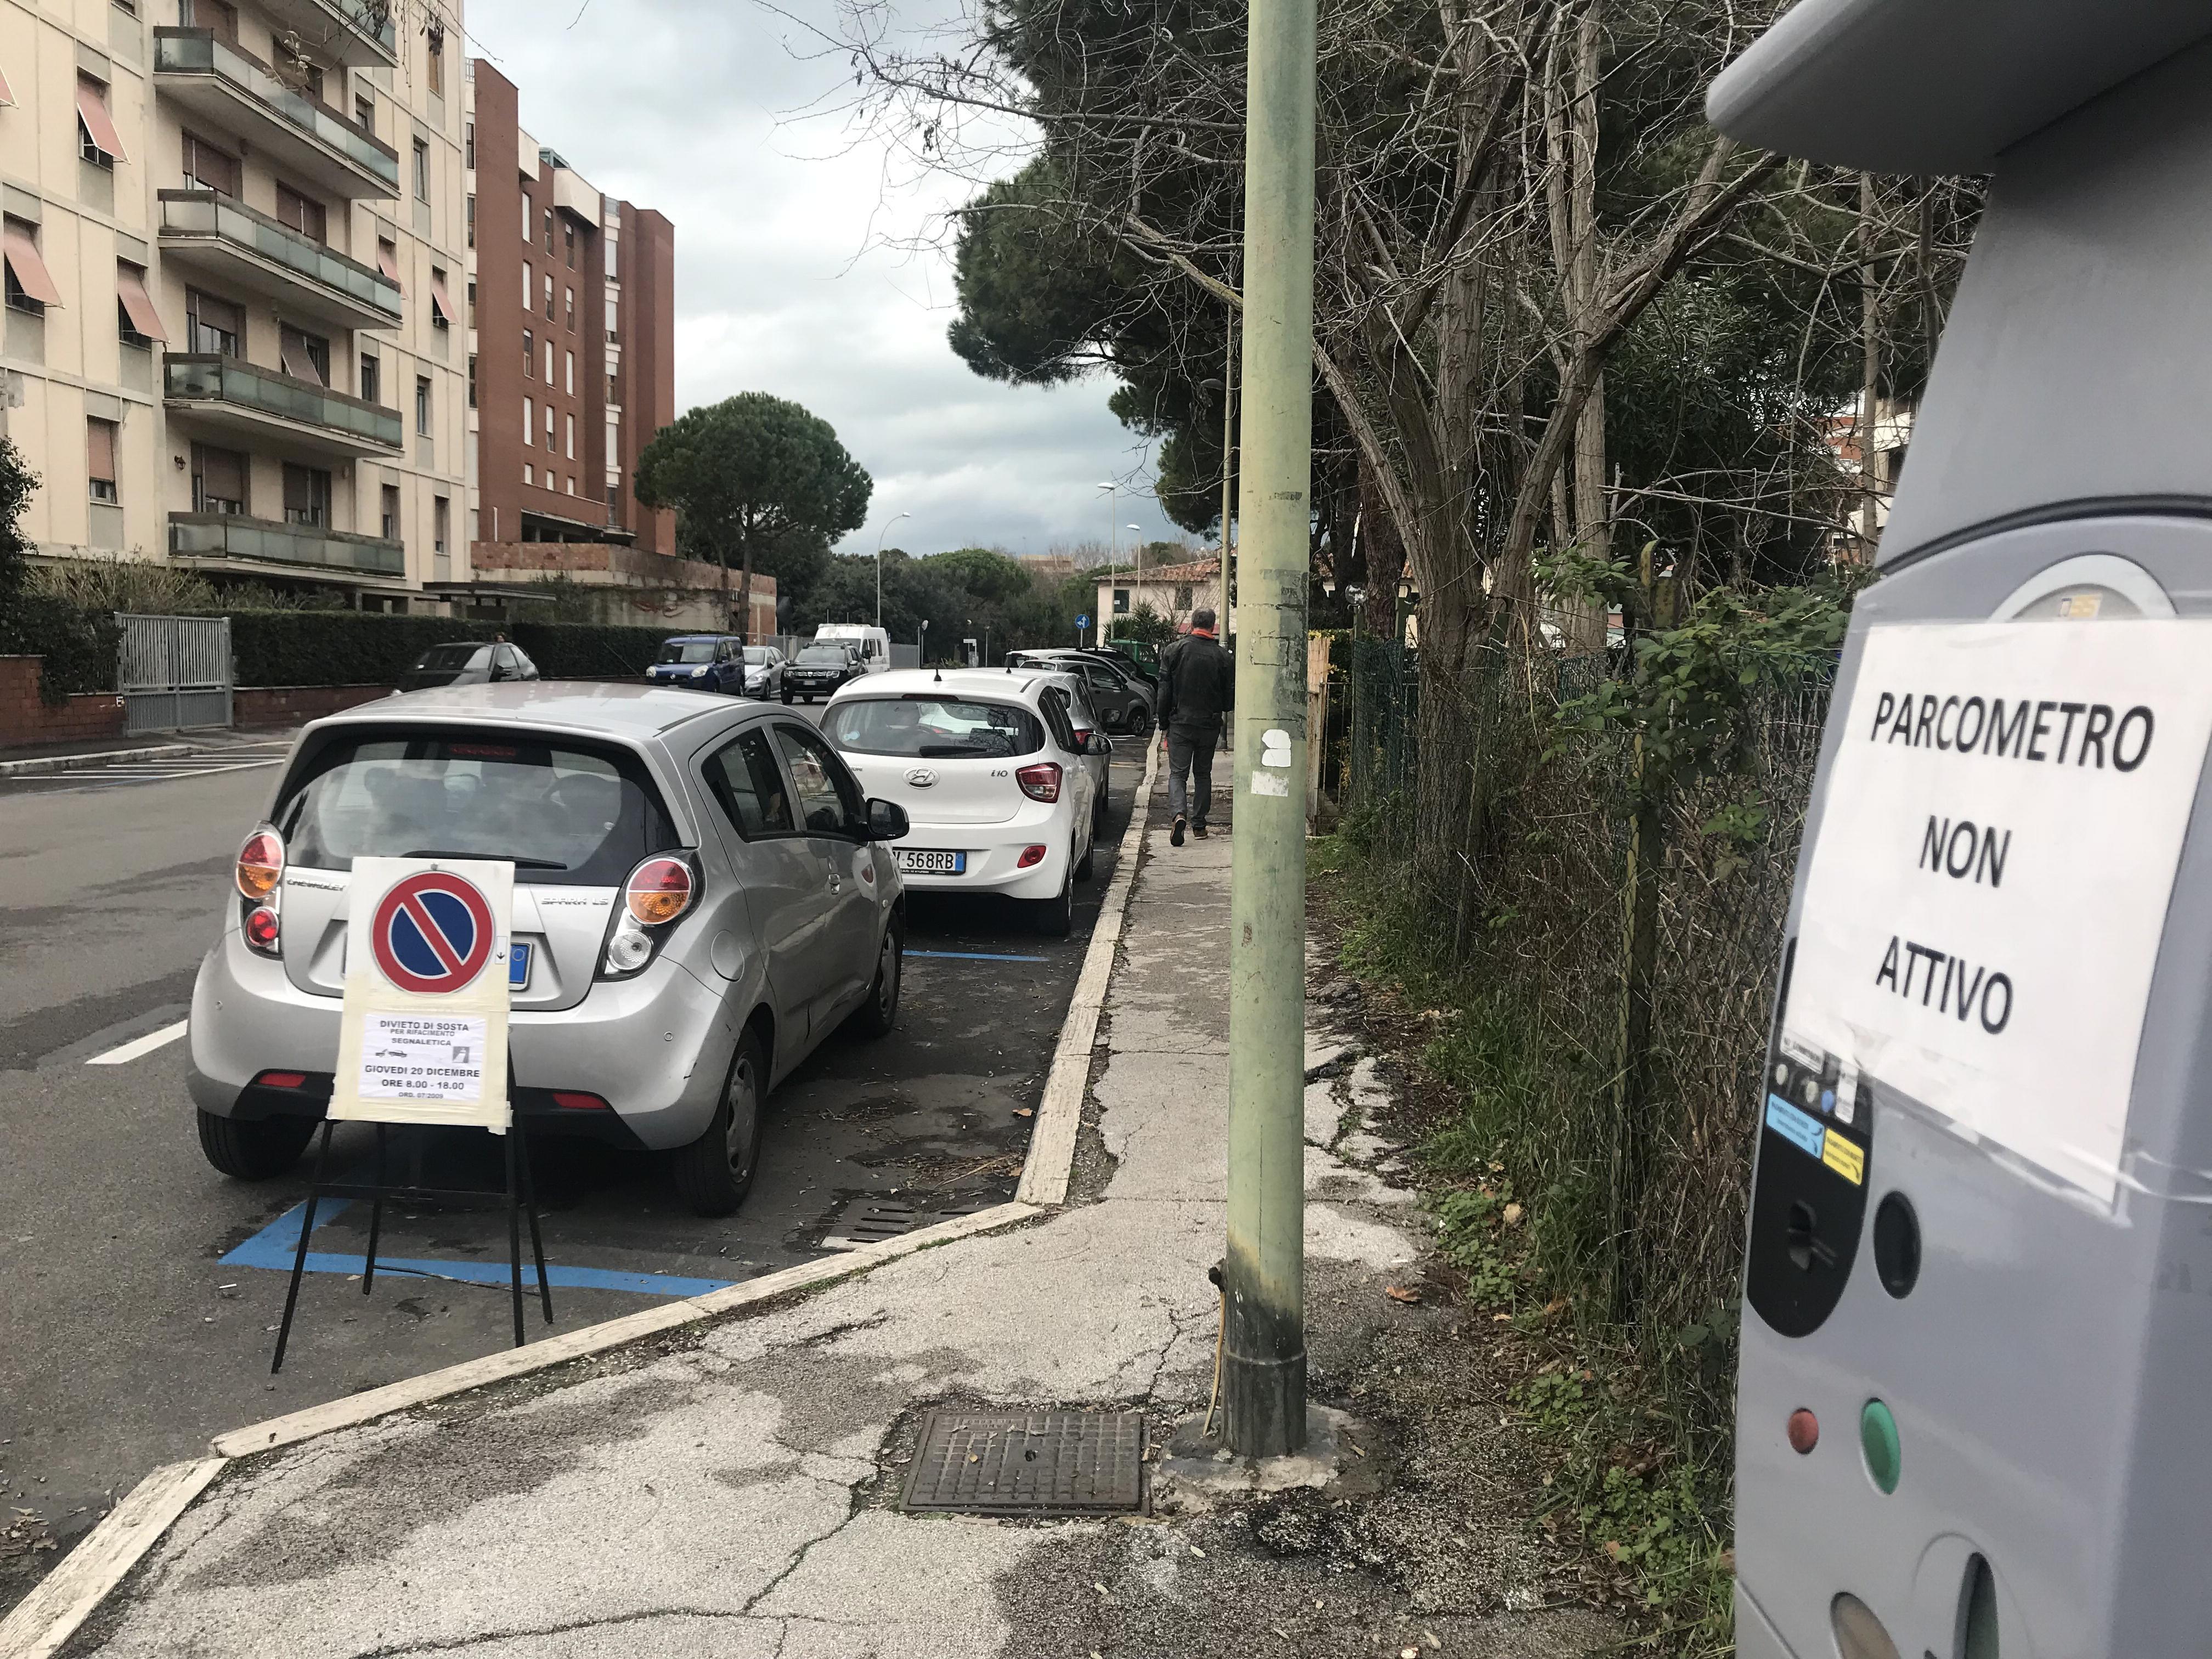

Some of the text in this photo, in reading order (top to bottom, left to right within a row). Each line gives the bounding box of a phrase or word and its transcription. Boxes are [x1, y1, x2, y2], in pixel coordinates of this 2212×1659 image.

[1870, 691, 2155, 773] PARCOMETRO
[1919, 815, 2013, 888] NON
[906, 852, 954, 869] 568RB
[1876, 935, 2015, 1035] ATTIVO
[380, 1020, 420, 1029] DIVIETO
[426, 1068, 480, 1077] DICEMBRE
[382, 1079, 403, 1087] ORE
[437, 1082, 465, 1090] 18.00
